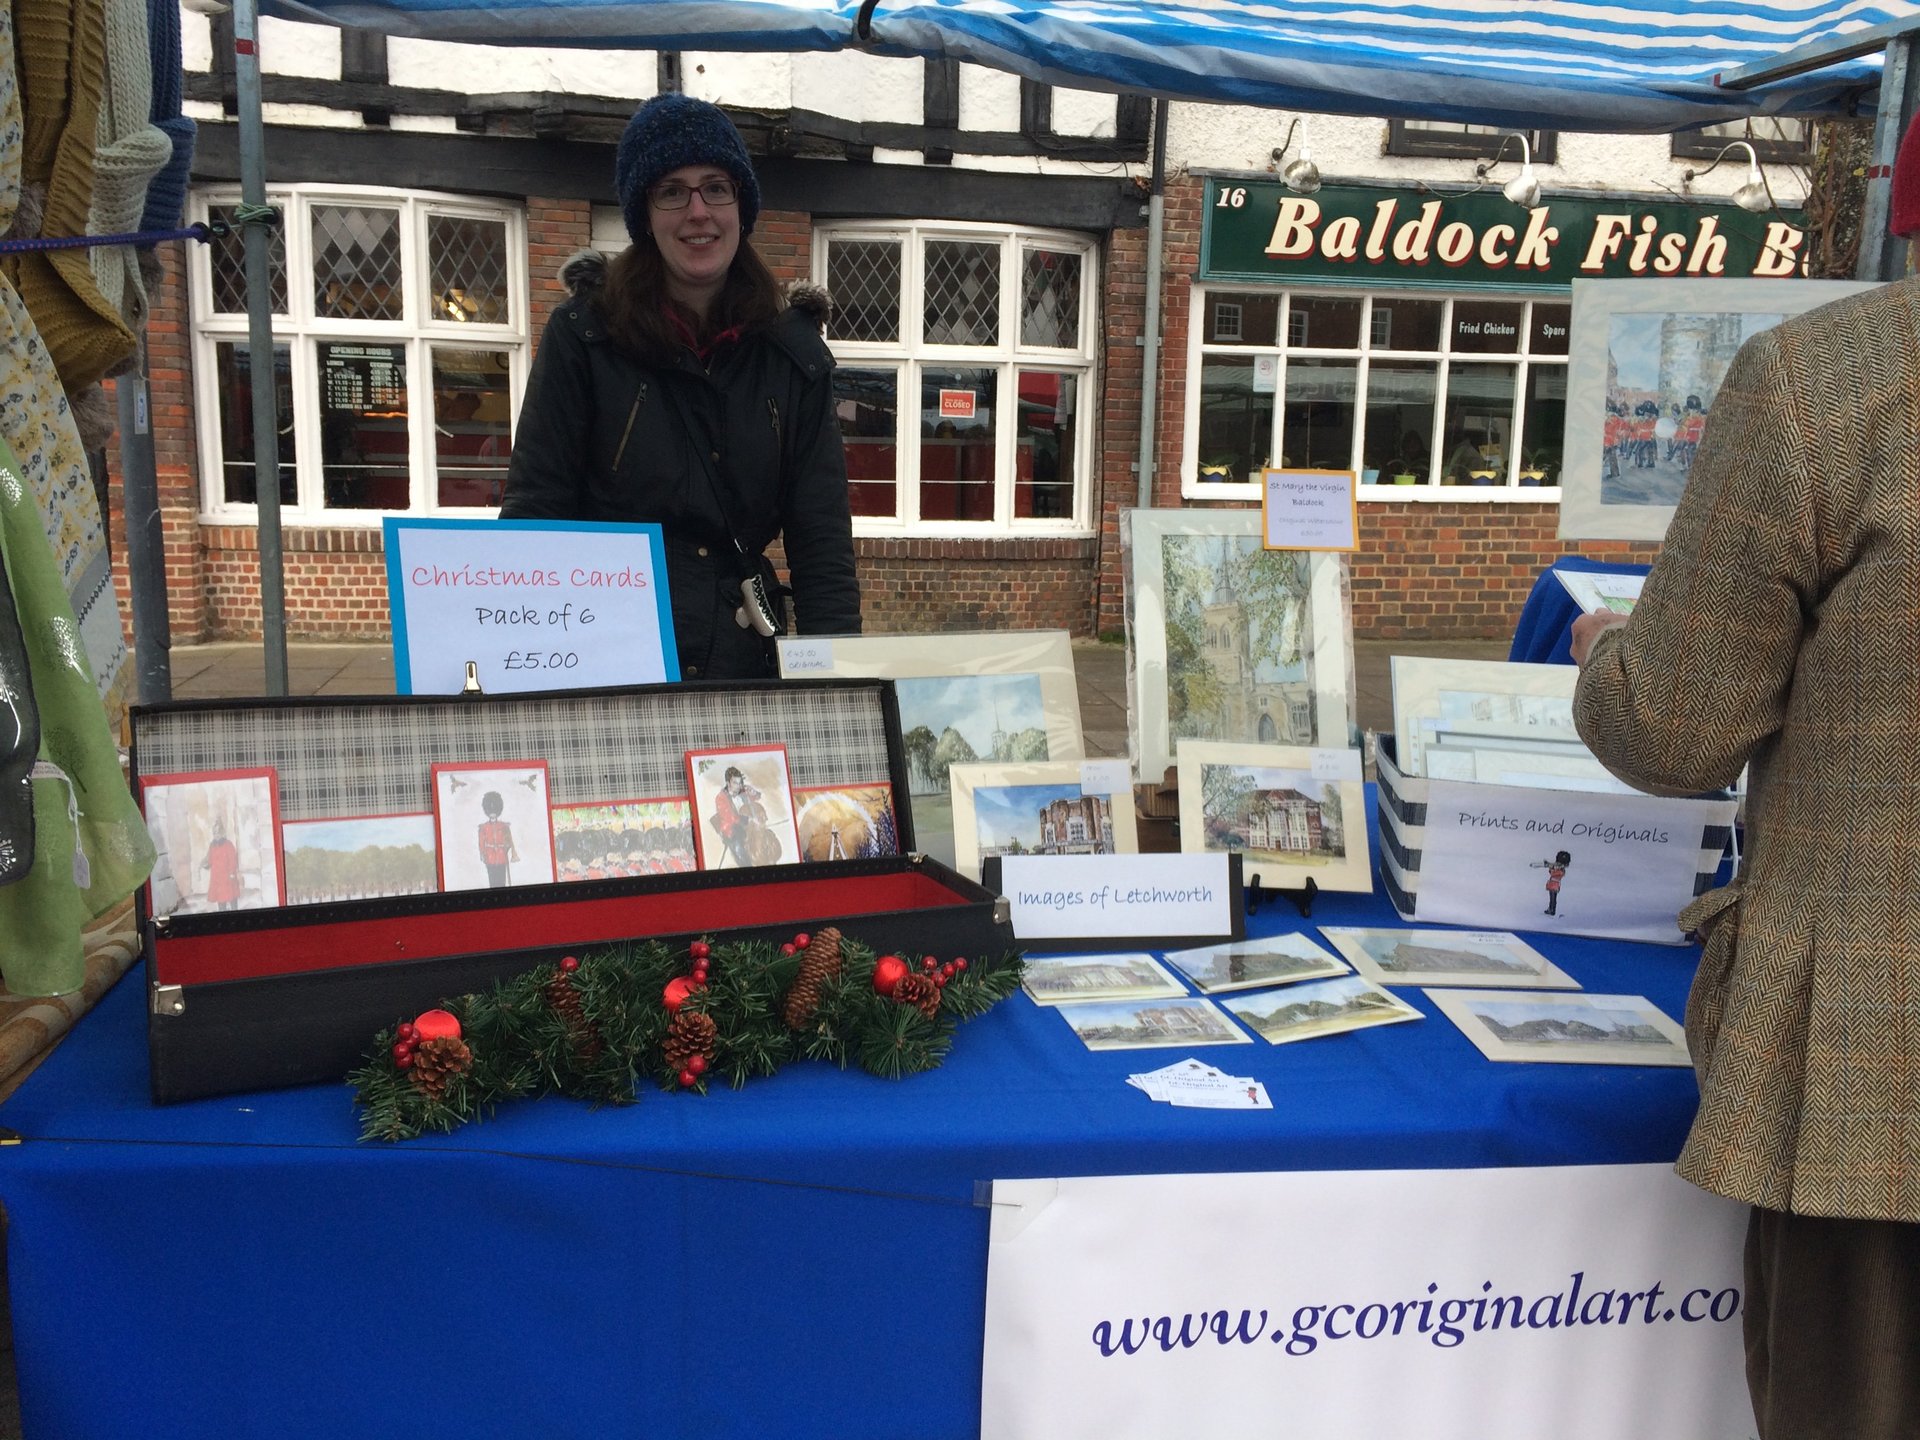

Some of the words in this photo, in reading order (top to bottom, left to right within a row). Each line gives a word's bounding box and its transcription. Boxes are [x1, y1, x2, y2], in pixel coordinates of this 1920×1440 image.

[1216, 187, 1246, 209] 16
[1264, 196, 1560, 268] Baldock
[1580, 214, 1727, 277] Fish
[1459, 321, 1480, 334] Fried
[1483, 322, 1516, 335] Chicken
[1542, 323, 1566, 339] Spare
[330, 346, 364, 354] OPENING
[944, 401, 971, 409] CLOSED
[1269, 482, 1280, 490] St
[1282, 482, 1304, 494] Mary
[1305, 483, 1318, 491] the
[1319, 483, 1346, 494] Virgin
[1292, 498, 1325, 507] Baldock
[411, 564, 561, 588] Christmas
[570, 566, 648, 588] Cards
[475, 604, 541, 625] Pack
[548, 602, 573, 631] of
[579, 608, 596, 624] 6
[503, 651, 579, 670] £5.00
[1458, 812, 1519, 832] Prints
[1525, 817, 1565, 835] and
[1570, 821, 1670, 845] Originals
[1018, 890, 1084, 910] Images
[1090, 885, 1110, 909] of
[1114, 886, 1213, 905] Letchworth
[1091, 1271, 1744, 1357] www.gcoriginalart.co
